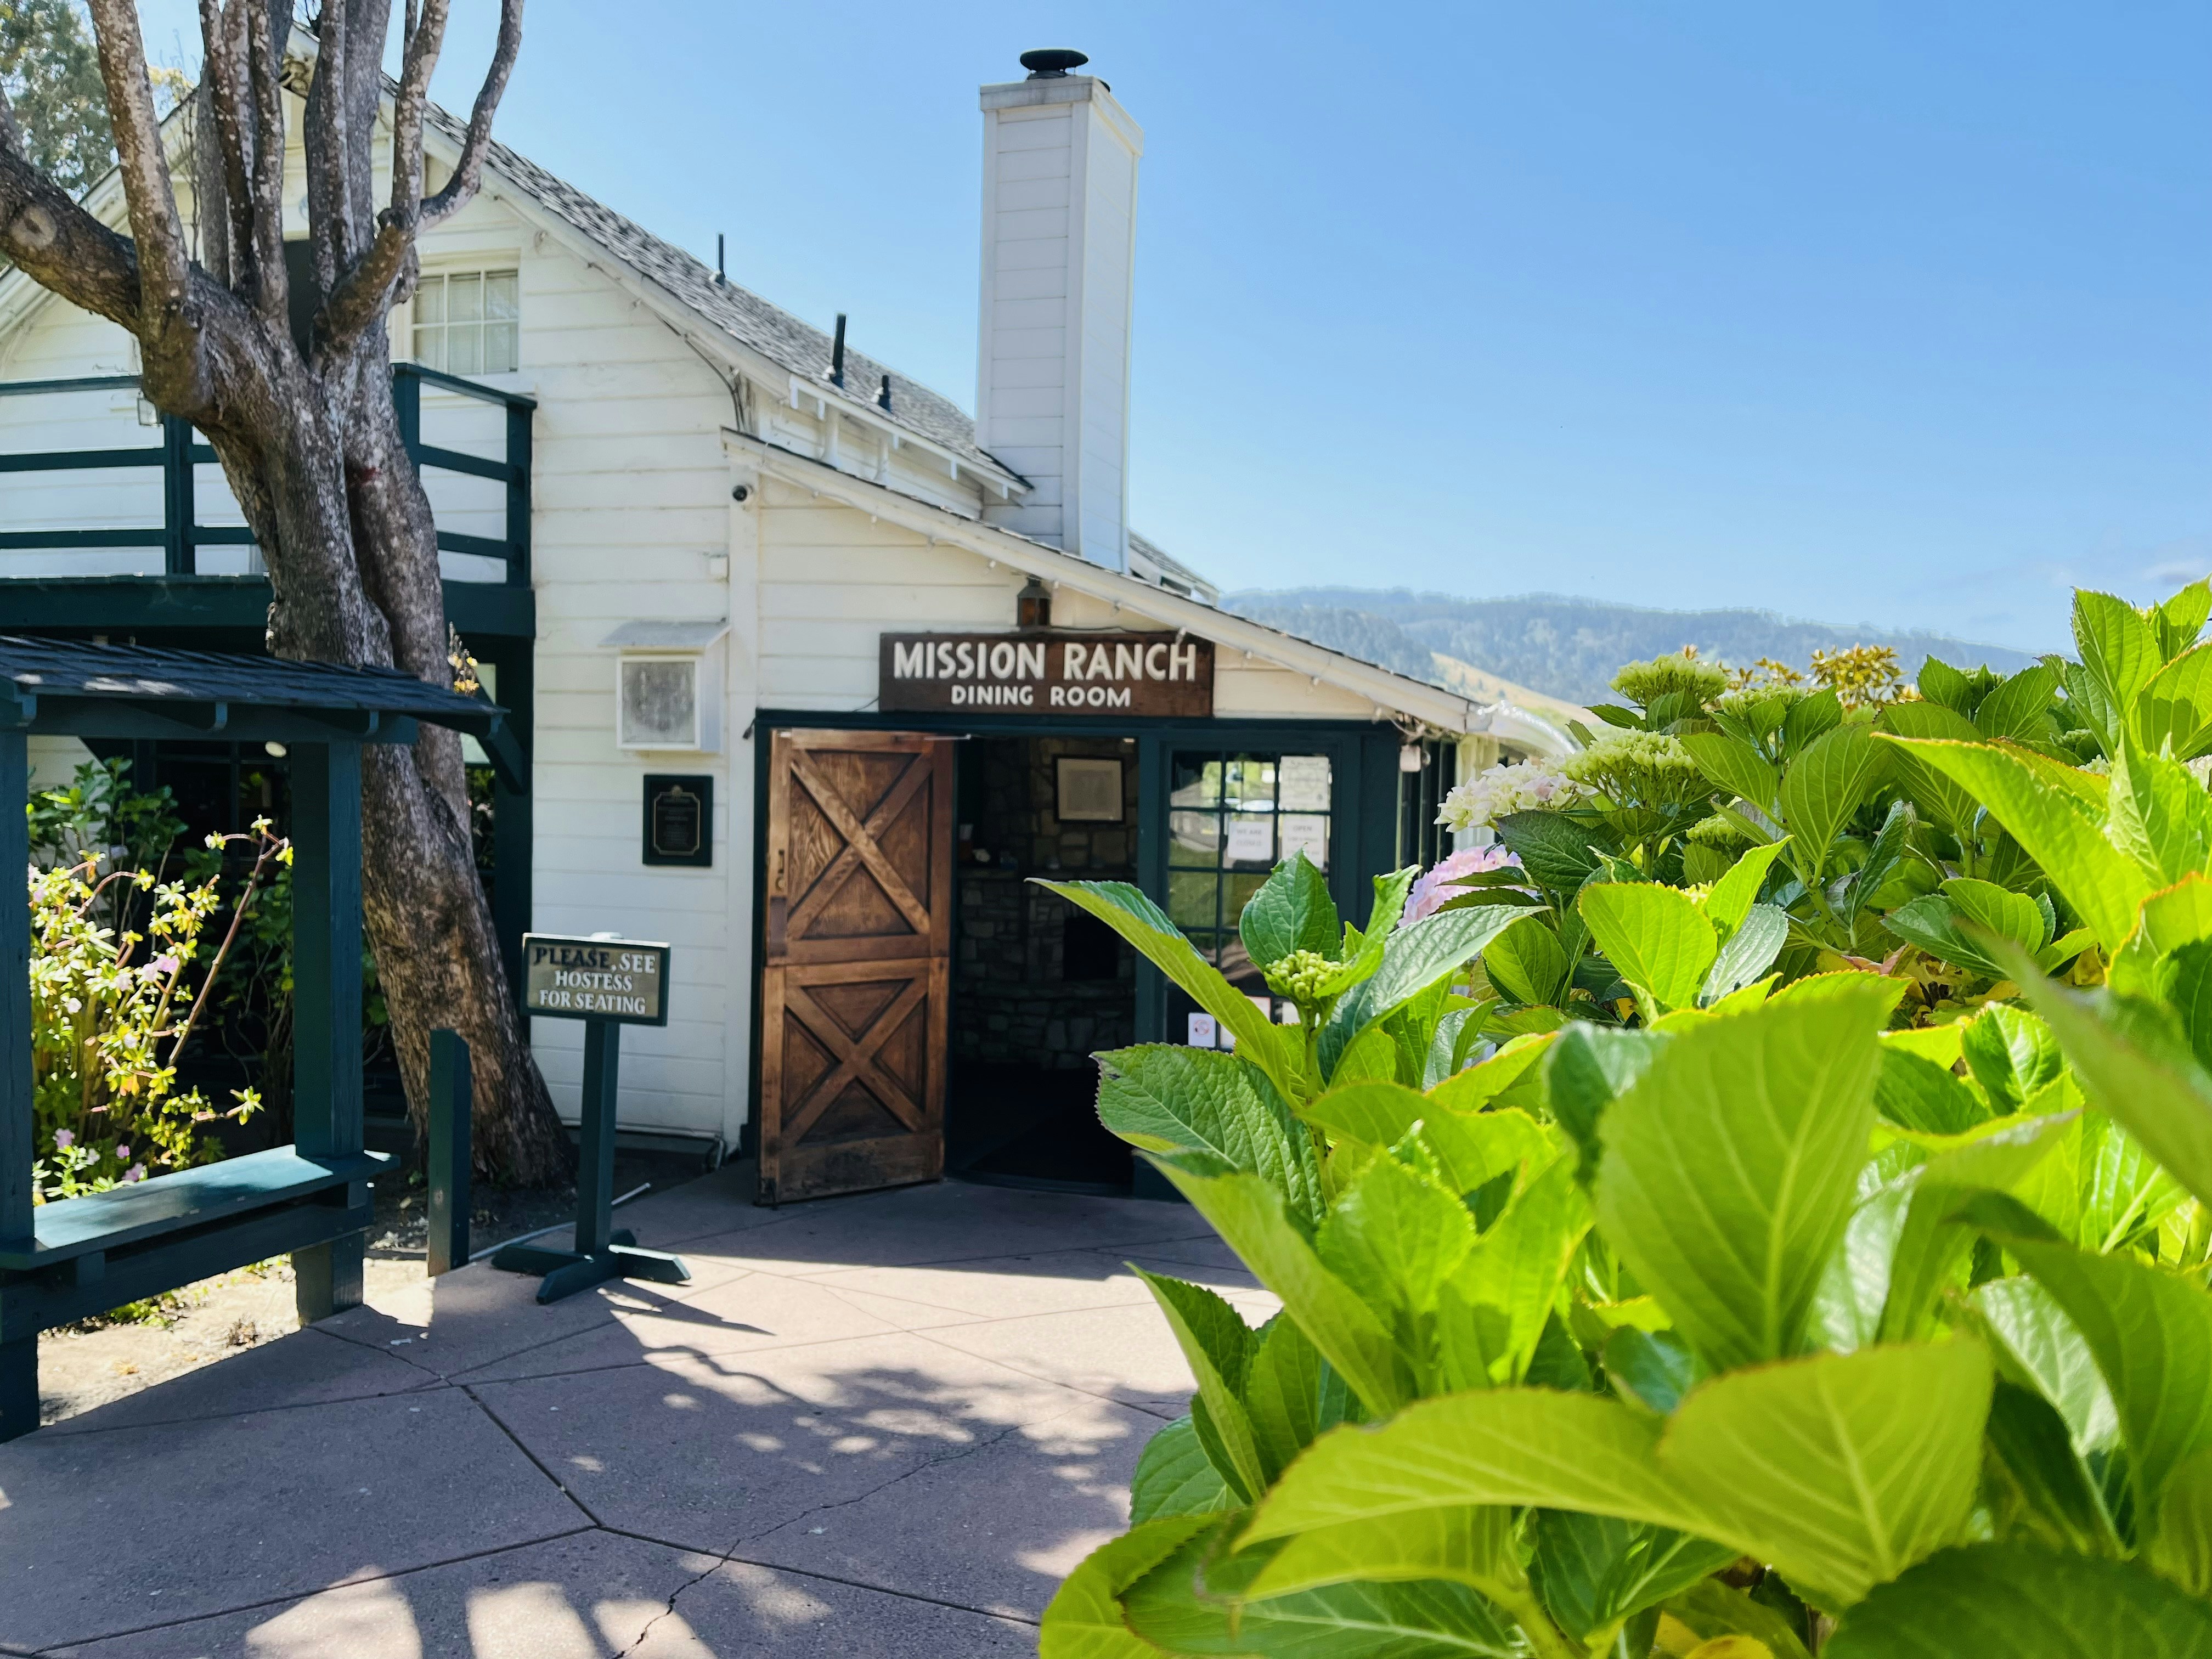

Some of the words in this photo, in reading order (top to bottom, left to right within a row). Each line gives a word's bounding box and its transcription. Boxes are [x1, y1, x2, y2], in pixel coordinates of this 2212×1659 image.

[893, 641, 1045, 680] MISSION
[1063, 642, 1197, 681] RANCH
[951, 685, 1034, 706] DINING
[1049, 686, 1131, 707] ROOM
[619, 953, 656, 974] SEE
[555, 970, 633, 994] HOSTESS
[539, 989, 571, 1008] FOR
[574, 992, 646, 1015] SEATING
